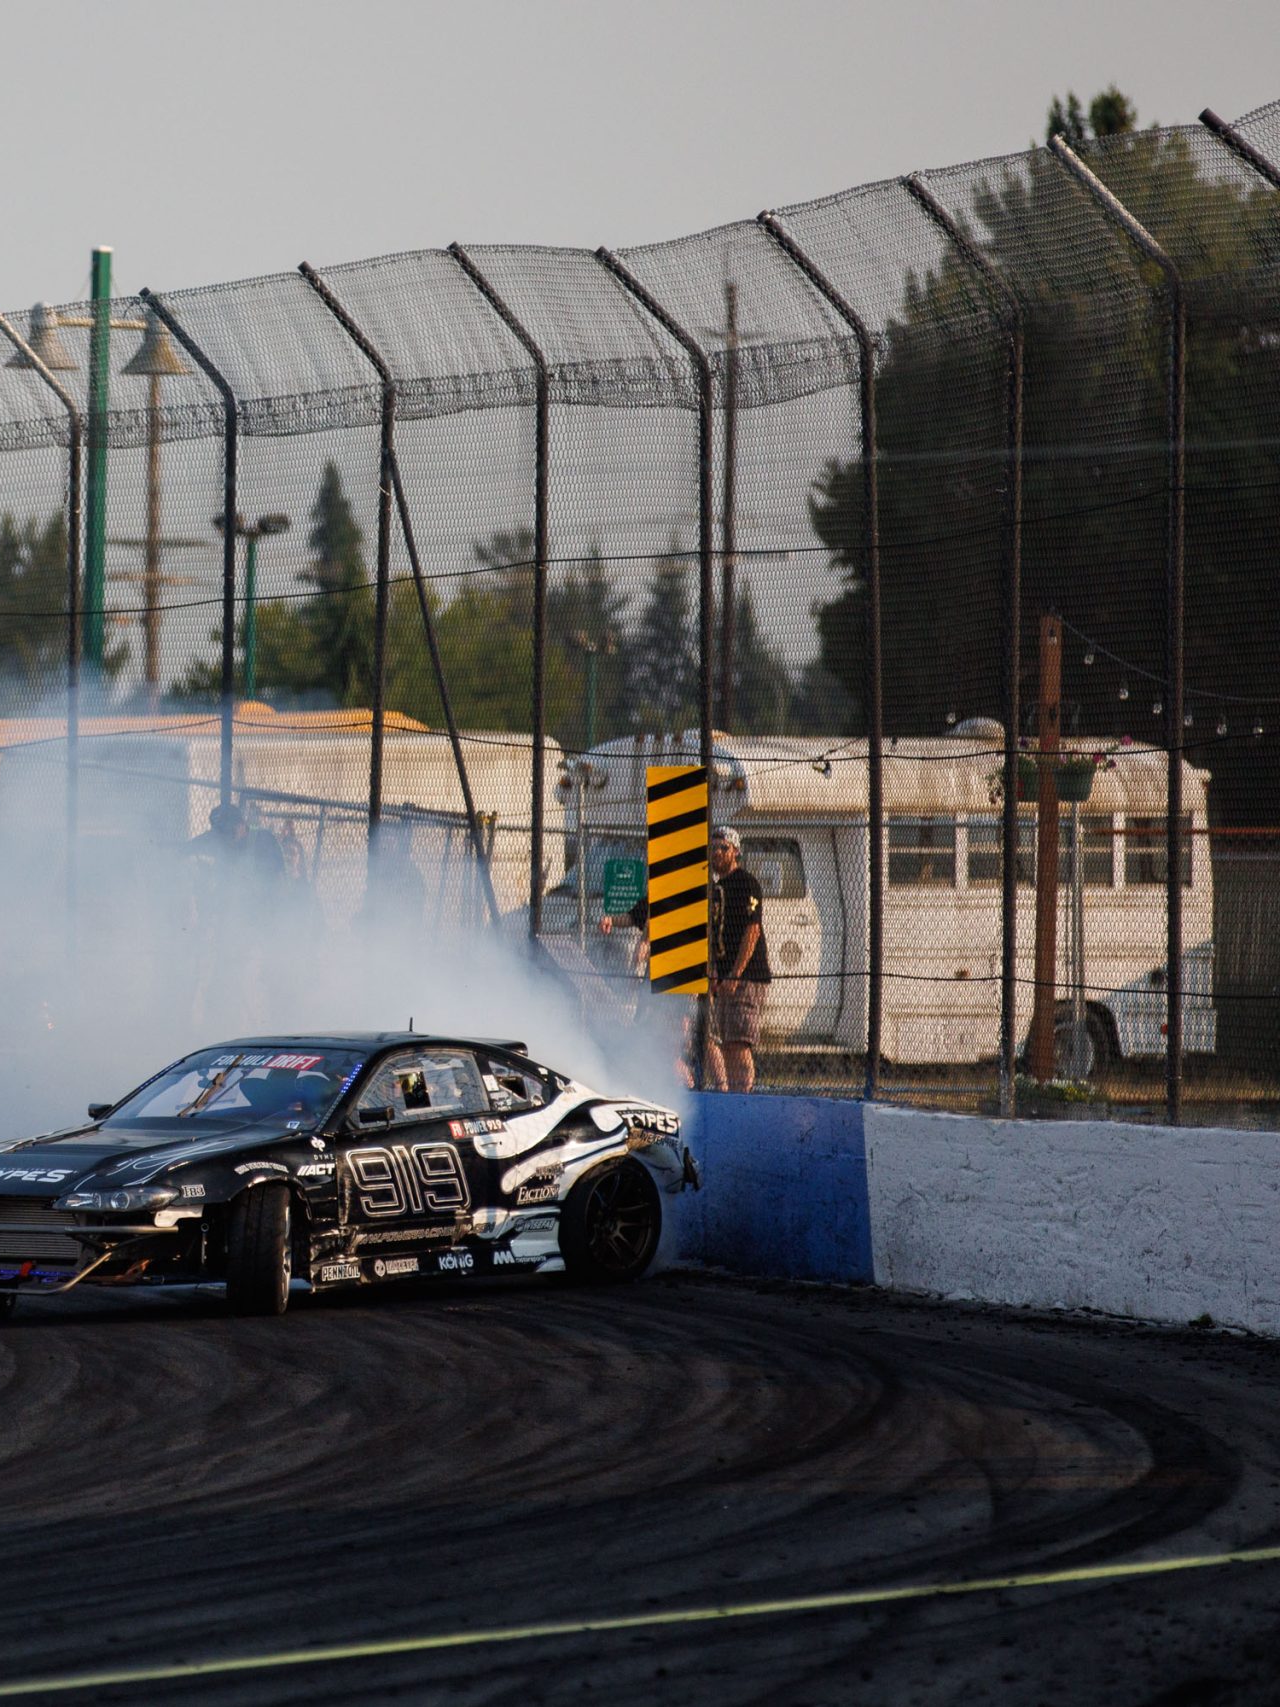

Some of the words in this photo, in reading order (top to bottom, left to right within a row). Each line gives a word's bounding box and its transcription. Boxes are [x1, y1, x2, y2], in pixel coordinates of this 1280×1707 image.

[266, 1055, 321, 1069] DRIFT
[463, 1120, 489, 1135] POWER
[486, 1119, 502, 1131] 919
[346, 1143, 470, 1217] 919
[439, 1253, 474, 1270] KÖNIG
[321, 1264, 361, 1282] PENNZOIL
